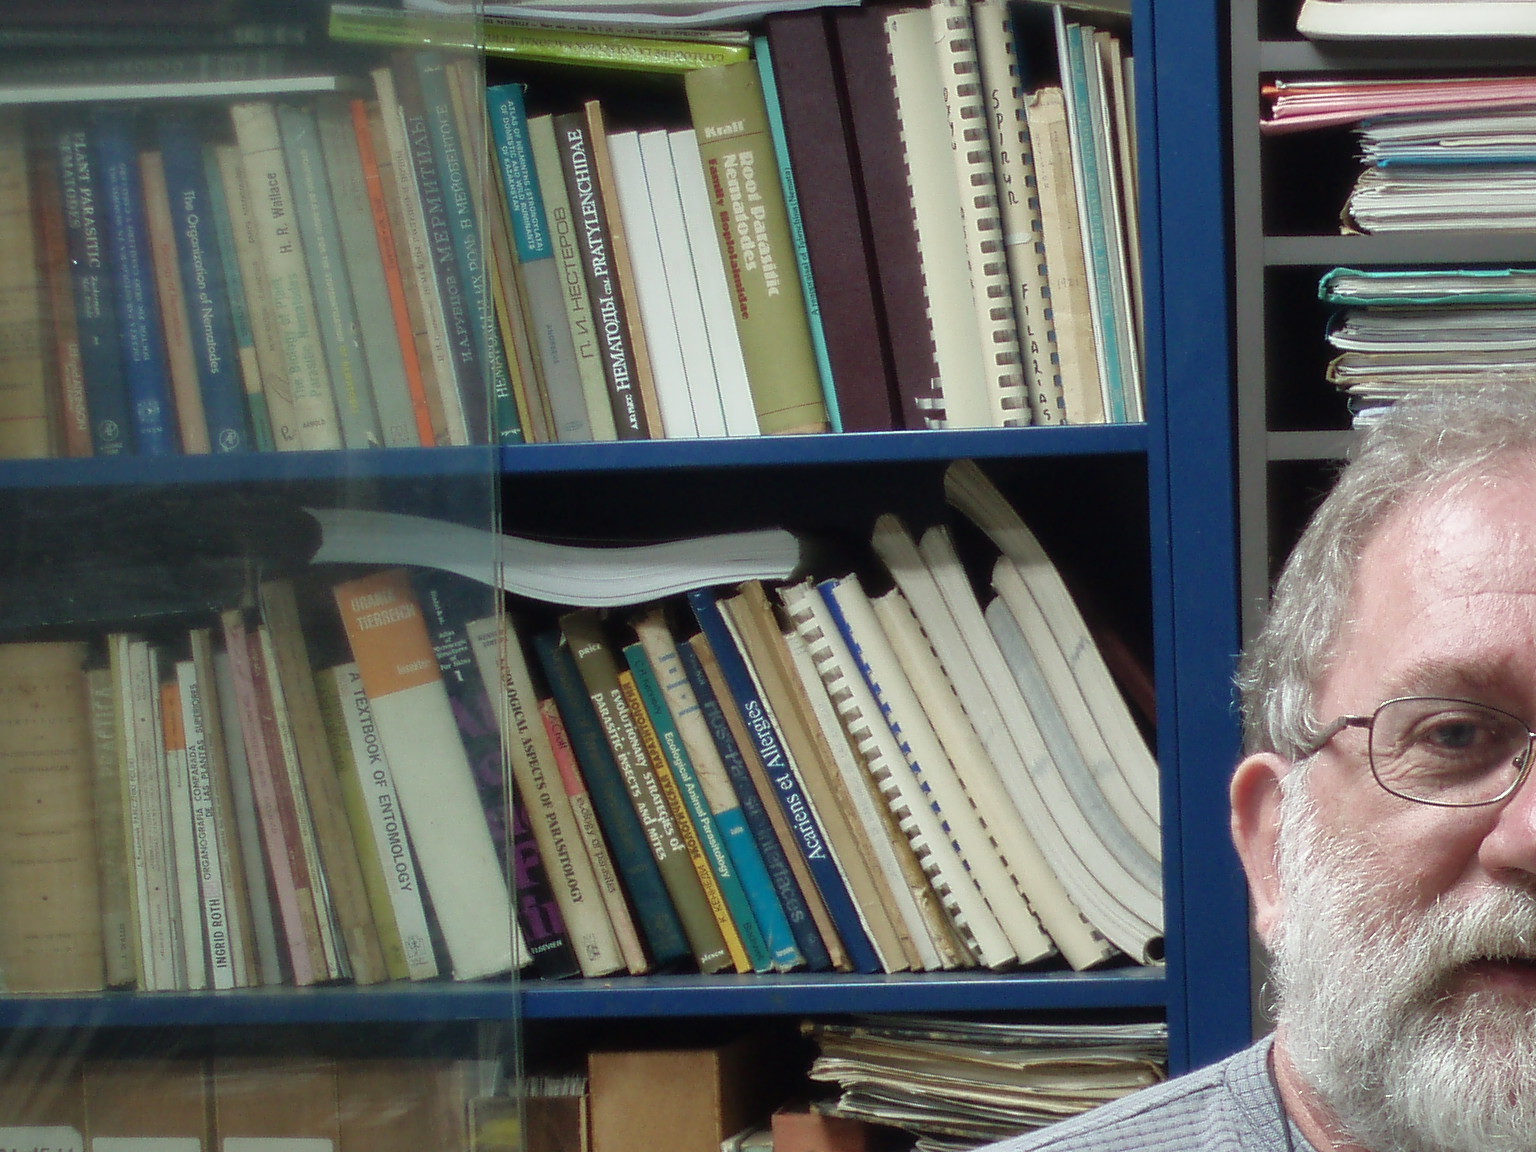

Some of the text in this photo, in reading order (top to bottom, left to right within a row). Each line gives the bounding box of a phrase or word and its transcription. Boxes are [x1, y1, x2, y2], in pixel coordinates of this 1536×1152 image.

[500, 104, 508, 116] OF
[502, 116, 516, 159] DOMESTIC
[507, 100, 518, 126] ATLAS
[513, 128, 521, 138] OF
[704, 119, 745, 139] Krall
[509, 160, 519, 175] AND
[567, 128, 608, 279] PRATYLENCHIDAE
[708, 158, 725, 206] Family
[80, 187, 101, 268] PARASITIC
[267, 172, 293, 254] H. R. Wallace
[723, 154, 757, 271] Nematodes
[738, 151, 780, 297] Root Parasitic
[183, 190, 222, 375] The Organization of Nematodes
[554, 206, 585, 311] НЕСТЕРОВ
[599, 295, 631, 392] НЕМАТОДЫ
[1021, 282, 1052, 422] FILARIAS
[197, 742, 209, 782] PLANTAS
[203, 786, 211, 802] LAS
[348, 672, 413, 892] A TEXTBOOK OF ENTOMOLOGY
[520, 735, 545, 793] ASPECTS
[745, 700, 826, 860] Acariens et Allergies
[188, 745, 211, 880] ORGANOGRAFIA COMPARADA
[205, 807, 213, 817] DE
[540, 793, 553, 813] OF
[641, 771, 675, 835] STRATEGIES
[663, 731, 689, 781] Ecological
[685, 781, 703, 817] Animal
[700, 817, 731, 879] Parasitology
[545, 812, 585, 905] PARASITOLOGY
[209, 898, 227, 968] INGRID ROTH
